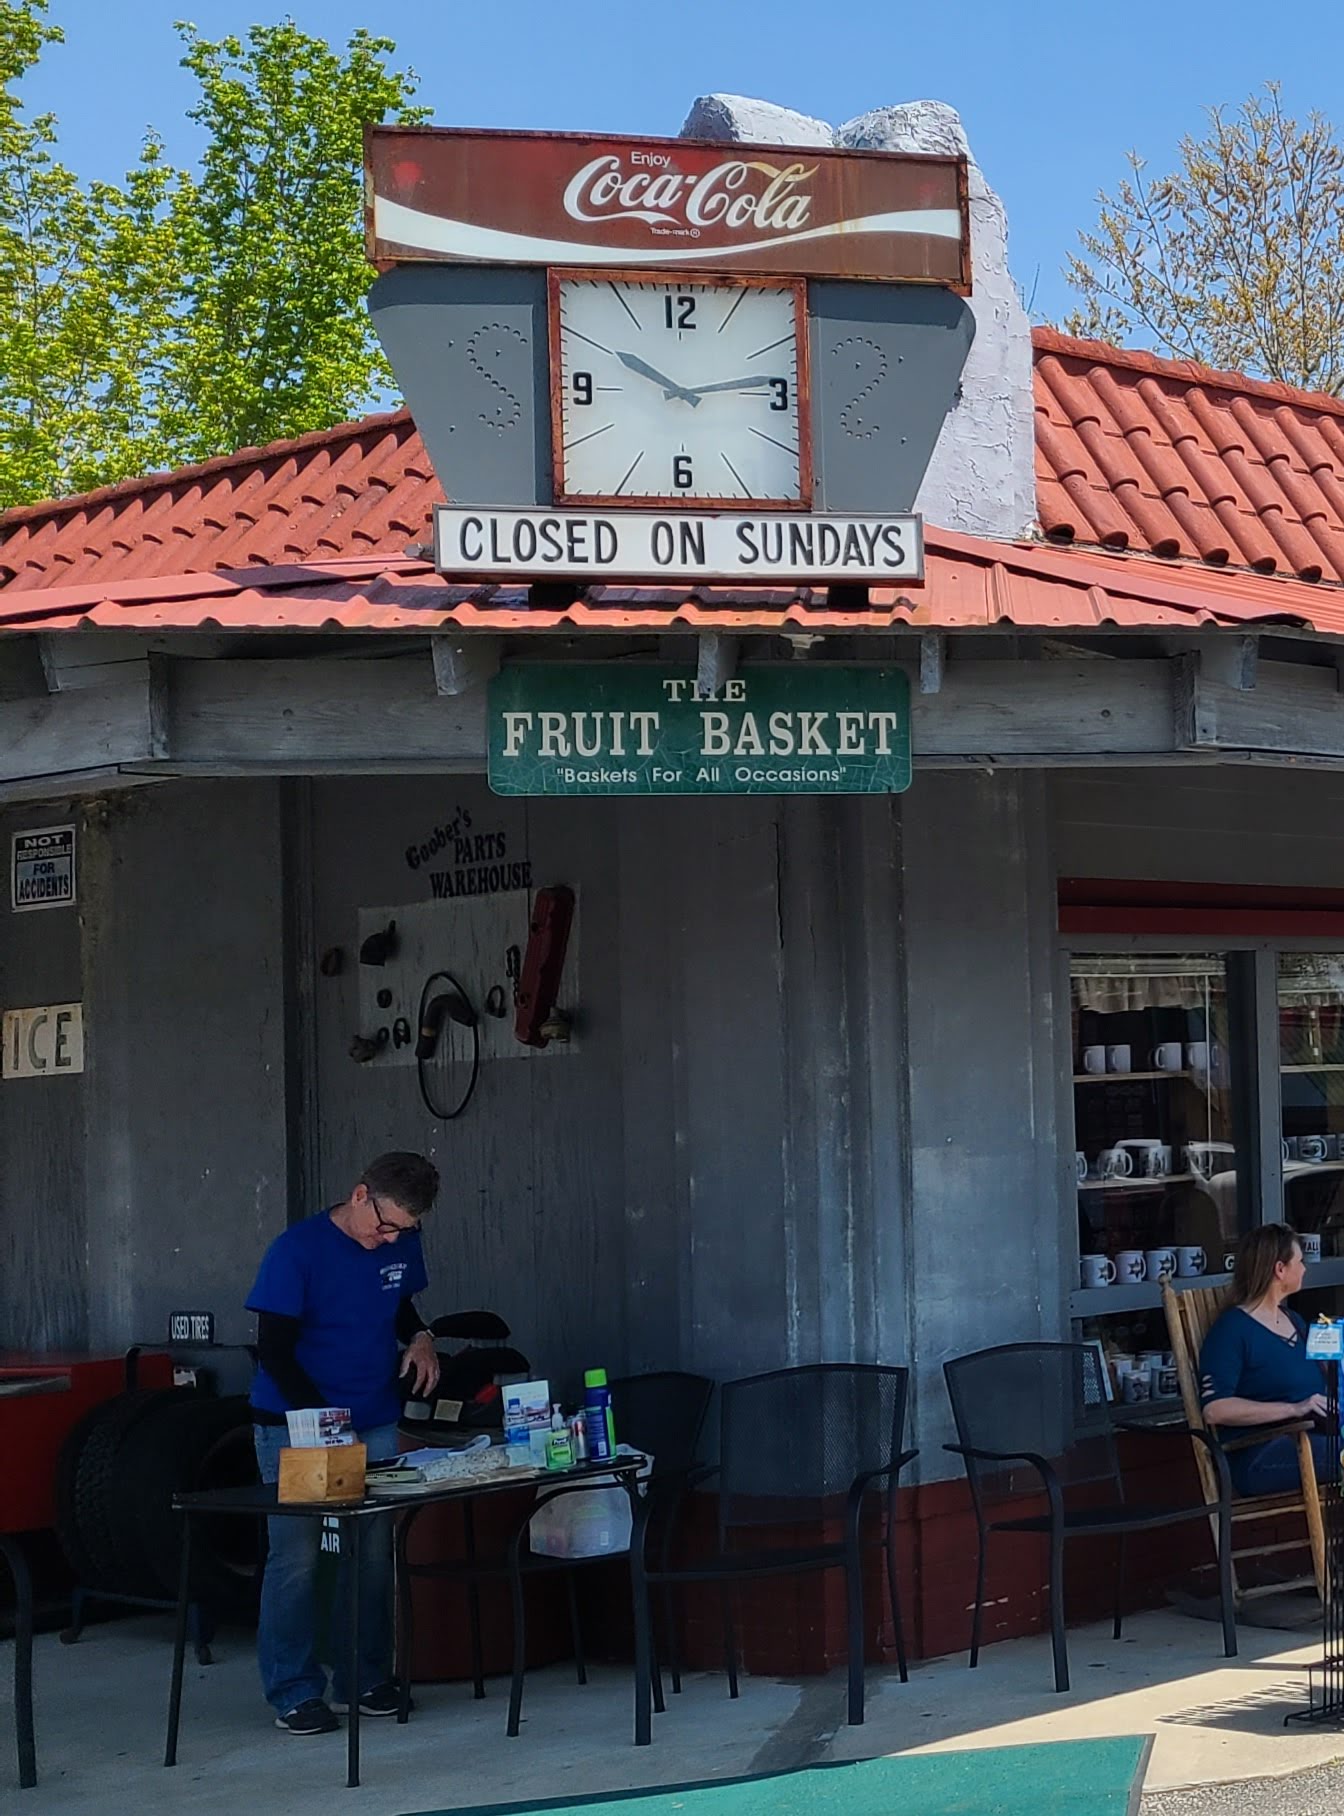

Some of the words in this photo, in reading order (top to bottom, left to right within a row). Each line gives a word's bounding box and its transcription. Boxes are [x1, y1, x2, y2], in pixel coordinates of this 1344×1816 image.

[631, 151, 671, 168] Enjoy
[563, 155, 820, 229] Coca-Cola
[664, 295, 698, 331] 12
[572, 372, 593, 406] 9
[769, 377, 788, 413] 3
[672, 455, 694, 489] 6
[459, 517, 618, 563] CLOSED
[651, 519, 705, 565] ON
[736, 521, 906, 567] SUNDAYS
[502, 712, 660, 757] FRUIT
[700, 711, 897, 756] BASKET
[556, 767, 637, 784] "Baskets
[652, 767, 682, 783] For
[696, 767, 720, 783] All
[735, 767, 847, 784] Occasions"
[17, 843, 72, 861] RESPONSIBLE
[24, 834, 64, 849] NOT
[405, 805, 472, 870] Goober's
[454, 832, 506, 864] PARTS
[33, 862, 55, 875] FOR
[429, 861, 533, 899] WAREHOUSE
[18, 874, 70, 901] ACCIDENTS
[13, 1011, 72, 1071] ICE
[171, 1315, 190, 1340] USED
[190, 1315, 210, 1340] TIRES
[320, 1531, 340, 1554] AIR
